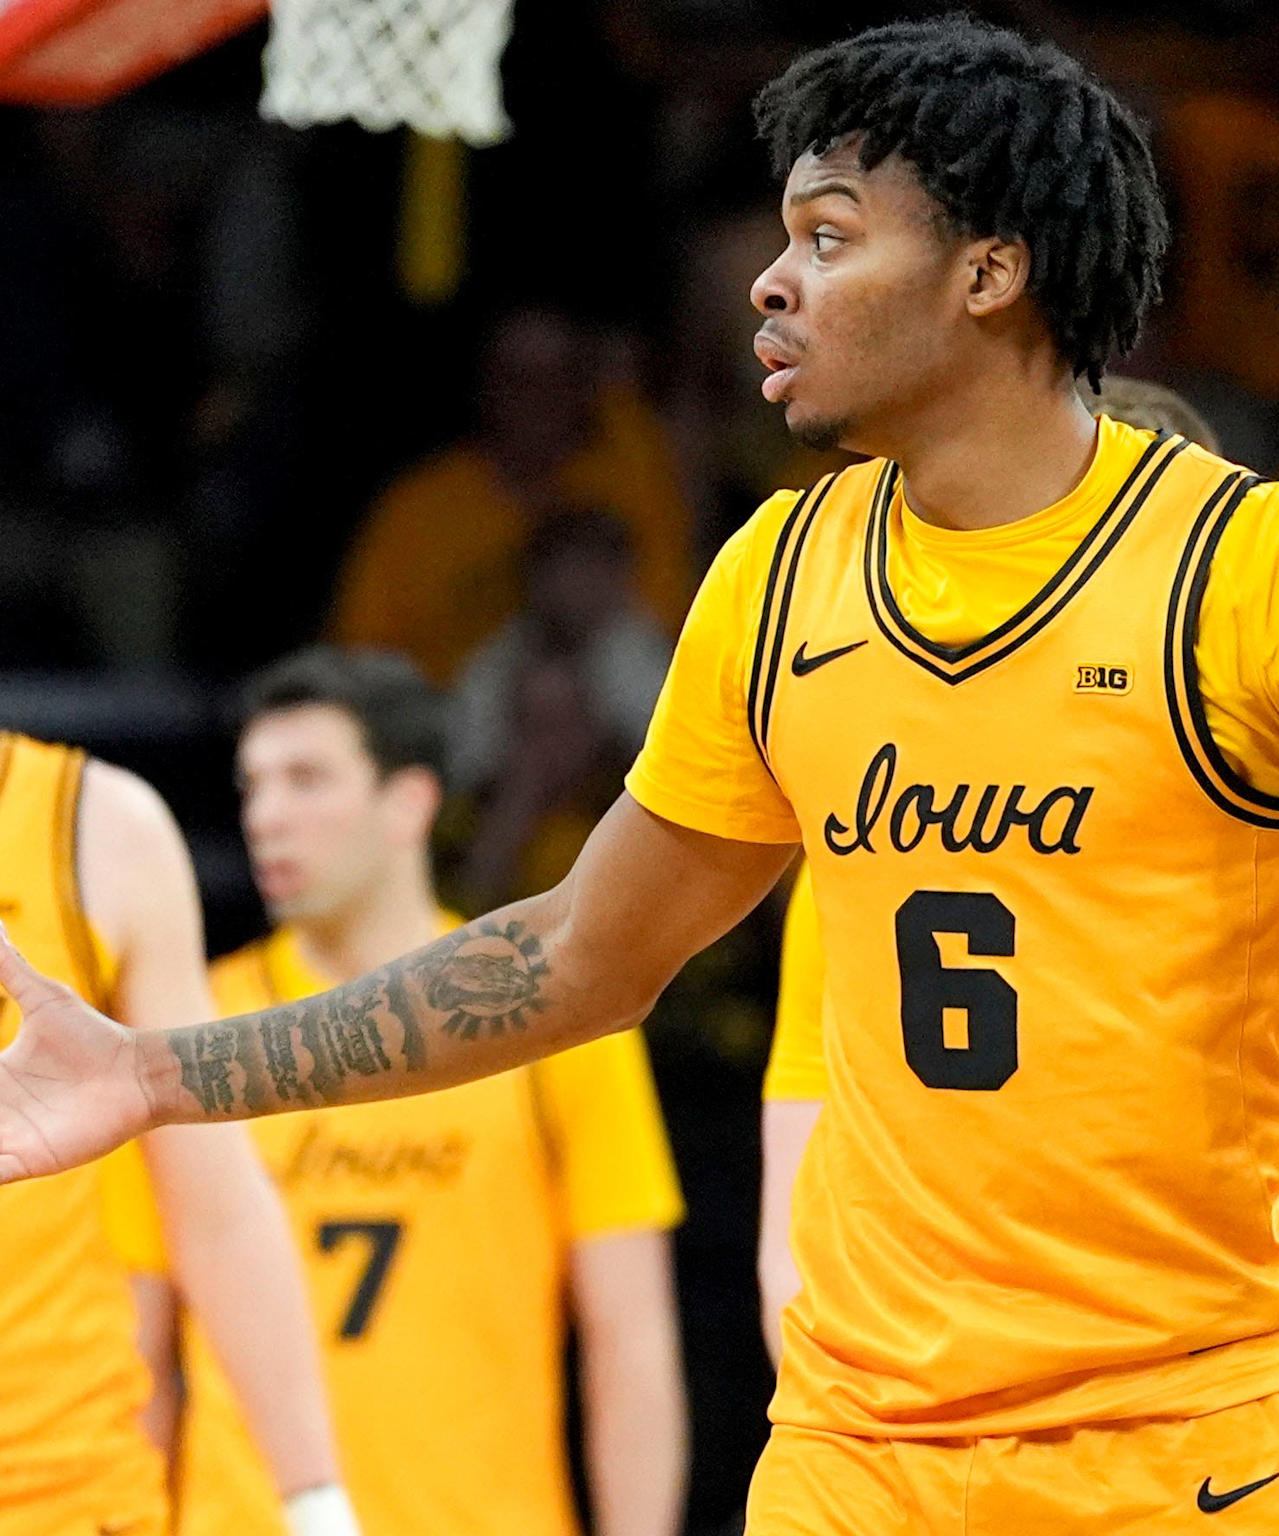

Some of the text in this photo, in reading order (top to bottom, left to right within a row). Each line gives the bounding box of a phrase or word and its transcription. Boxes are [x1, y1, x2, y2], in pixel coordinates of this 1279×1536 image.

[824, 742, 1095, 856] Iowa
[895, 889, 1018, 1092] 6
[317, 1218, 402, 1341] 7
